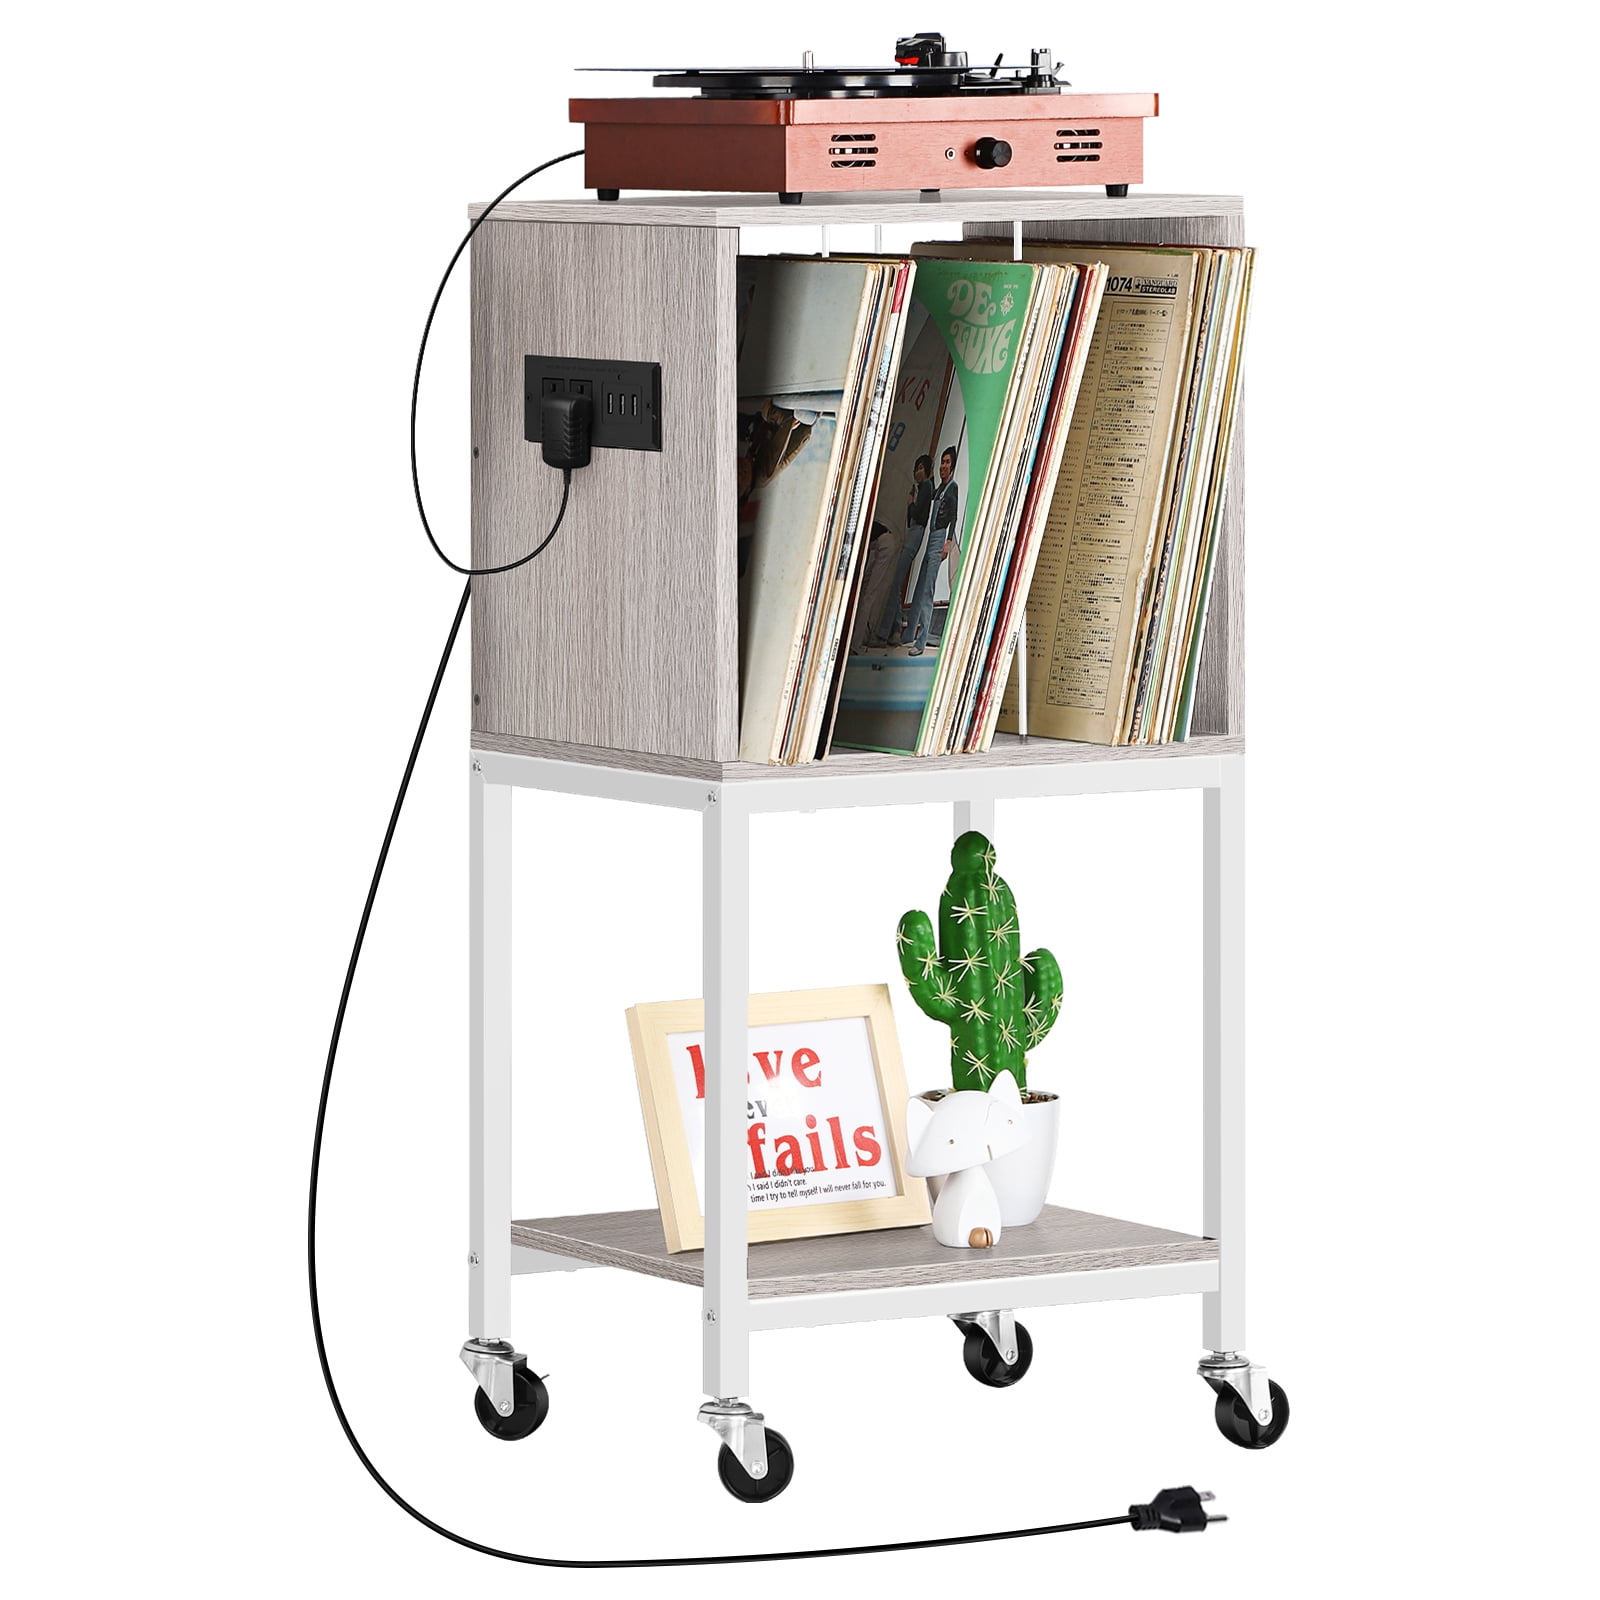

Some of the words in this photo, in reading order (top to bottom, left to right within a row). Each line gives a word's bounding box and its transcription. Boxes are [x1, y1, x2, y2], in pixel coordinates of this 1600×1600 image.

[1106, 276, 1133, 292] 1074
[1141, 286, 1177, 295] STEREOLAB
[947, 279, 997, 325] DE
[950, 318, 1017, 374] LUXE
[686, 1044, 822, 1099] lve
[747, 1114, 882, 1180] fails
[750, 1193, 765, 1203] time
[769, 1192, 779, 1202] try
[779, 1191, 787, 1200] to
[787, 1188, 798, 1198] tell
[799, 1185, 818, 1199] myself
[822, 1184, 833, 1193] will
[834, 1183, 851, 1192] never
[851, 1180, 862, 1190] fall
[862, 1179, 872, 1189] for
[872, 1180, 887, 1190] you.
[756, 1181, 770, 1191] said
[774, 1179, 793, 1189] didn't
